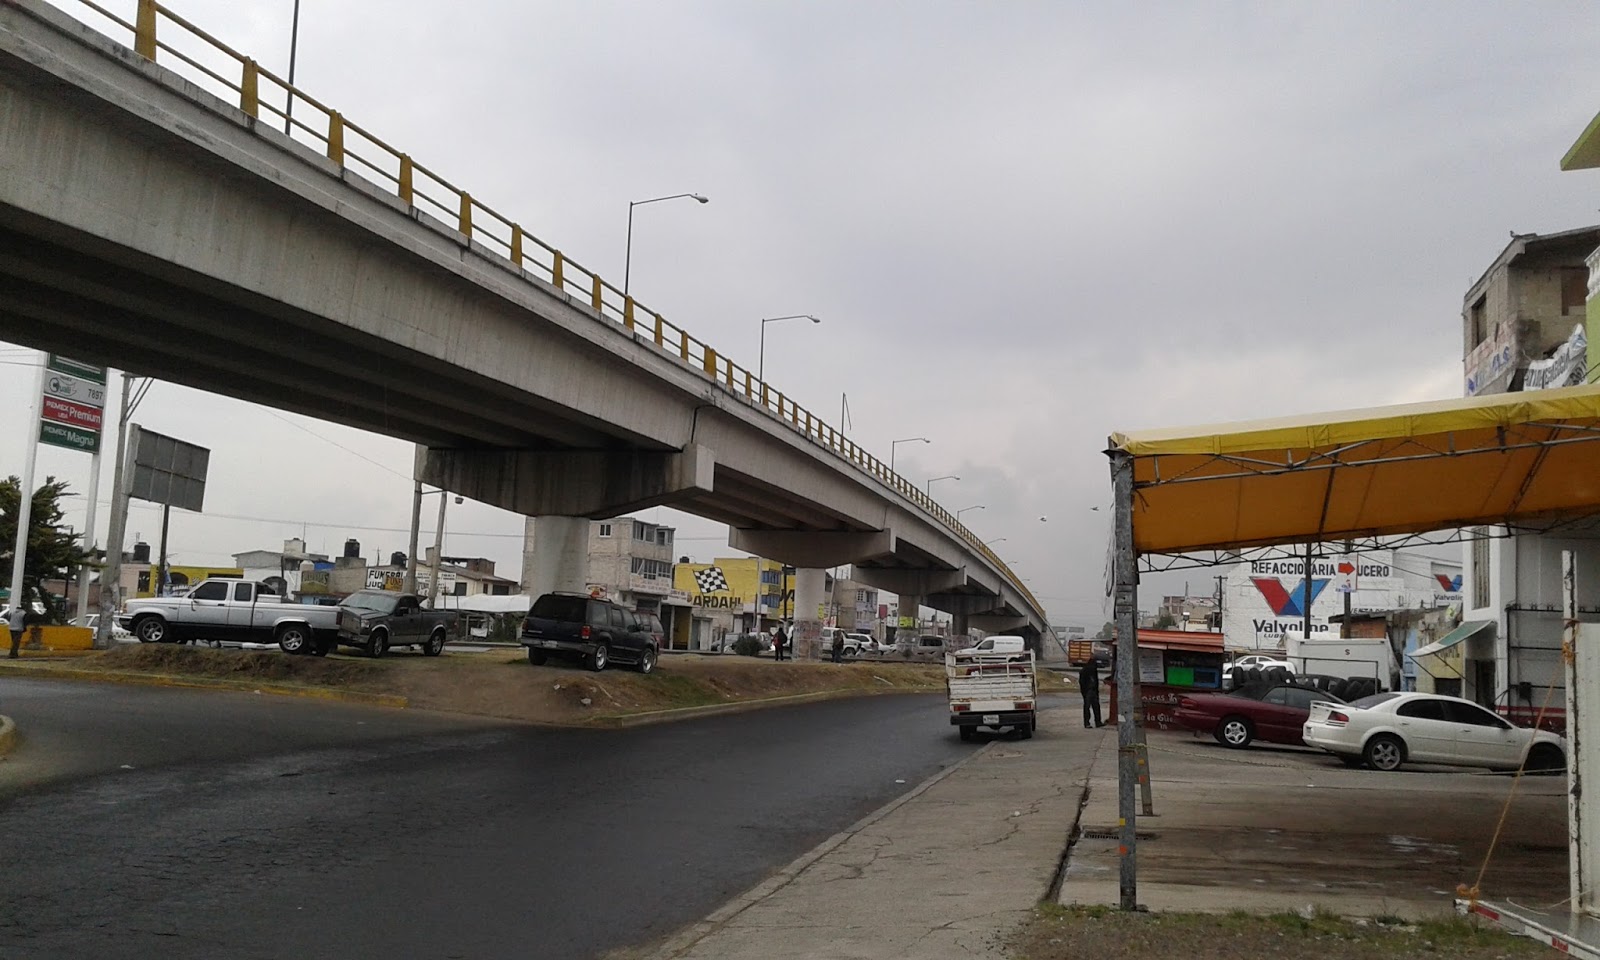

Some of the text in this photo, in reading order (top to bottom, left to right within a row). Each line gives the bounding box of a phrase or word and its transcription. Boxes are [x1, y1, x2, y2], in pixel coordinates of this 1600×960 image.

[88, 388, 104, 401] 7897
[46, 400, 101, 423] PEMEX Premium
[43, 425, 95, 447] PEMEX Magna
[1251, 561, 1337, 576] REFACCIOARIA
[1253, 618, 1329, 633] Valvolne
